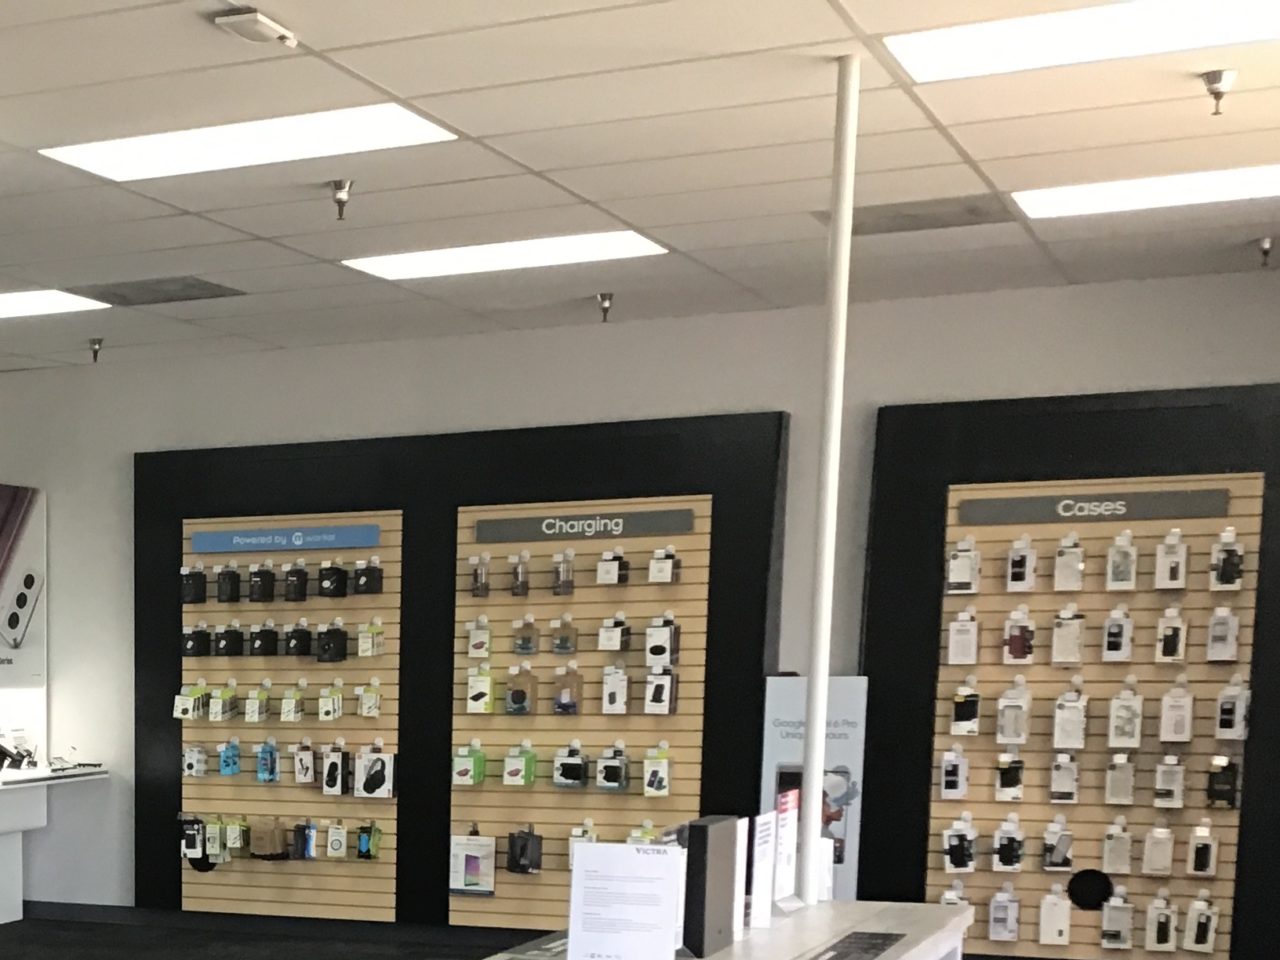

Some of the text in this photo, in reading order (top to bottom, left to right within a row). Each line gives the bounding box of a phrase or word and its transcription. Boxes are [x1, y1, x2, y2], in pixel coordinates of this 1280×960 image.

[1057, 499, 1128, 517] Cases
[542, 516, 624, 536] Charging
[232, 535, 273, 545] Powered
[274, 535, 287, 545] by
